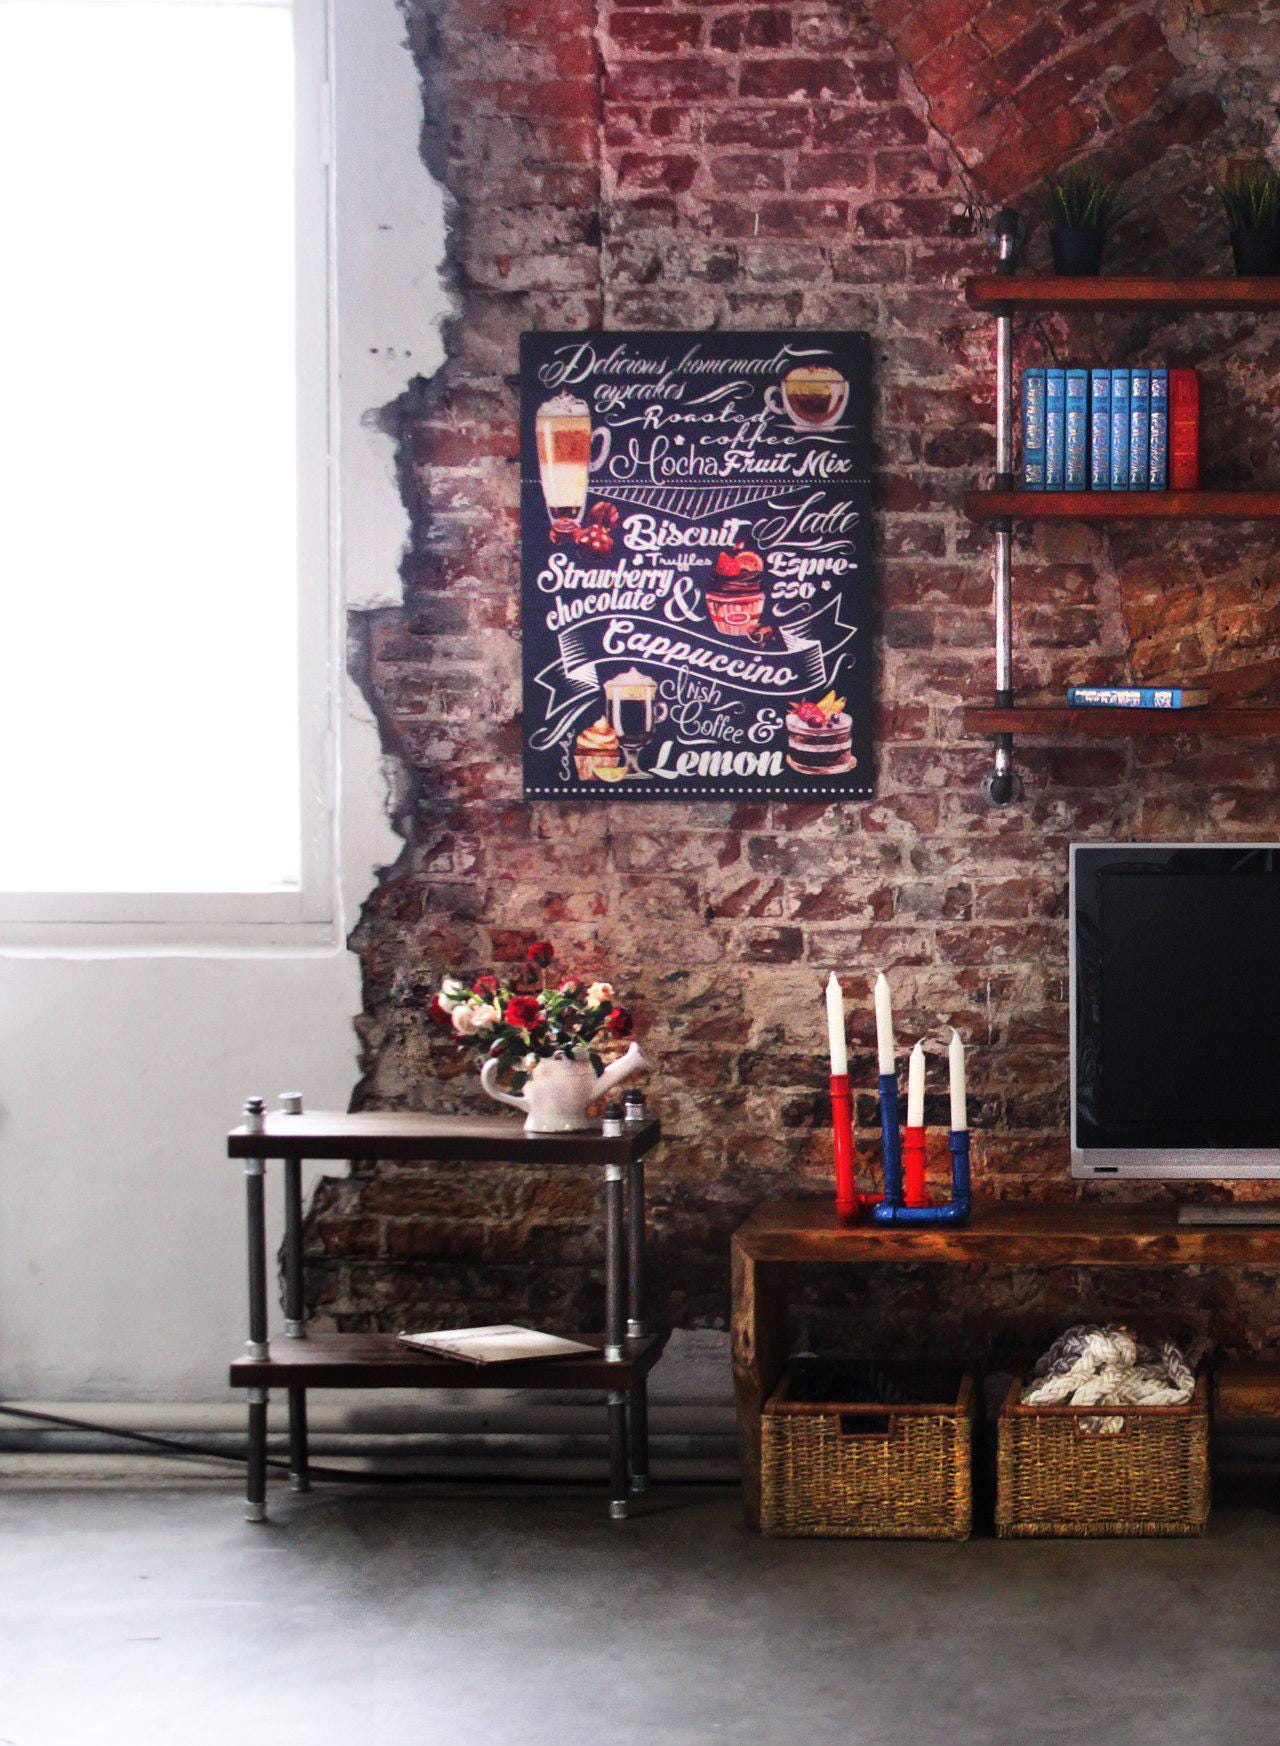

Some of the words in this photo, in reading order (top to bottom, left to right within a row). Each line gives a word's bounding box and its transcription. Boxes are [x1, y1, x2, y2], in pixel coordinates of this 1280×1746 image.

[537, 341, 667, 388] Delicious
[677, 343, 795, 376] homemade
[593, 371, 688, 412] cupcakes
[643, 402, 775, 430] Roasted
[699, 422, 800, 450] coffee
[609, 434, 718, 485] Mocha
[719, 450, 793, 478] Fruit
[793, 450, 852, 478] Mix
[623, 514, 752, 550] Biscuit
[752, 491, 861, 550] Latte
[537, 553, 674, 597] Strawberry
[650, 553, 713, 571] Truffles
[767, 552, 858, 582] Espre-
[546, 586, 657, 631] chocolate
[664, 576, 707, 622] &
[771, 581, 815, 599] sso
[602, 618, 798, 686] Cappuccino
[659, 665, 722, 706] Irish
[670, 700, 745, 744] Coffee
[747, 708, 784, 744] &
[649, 740, 784, 779] Lemon
